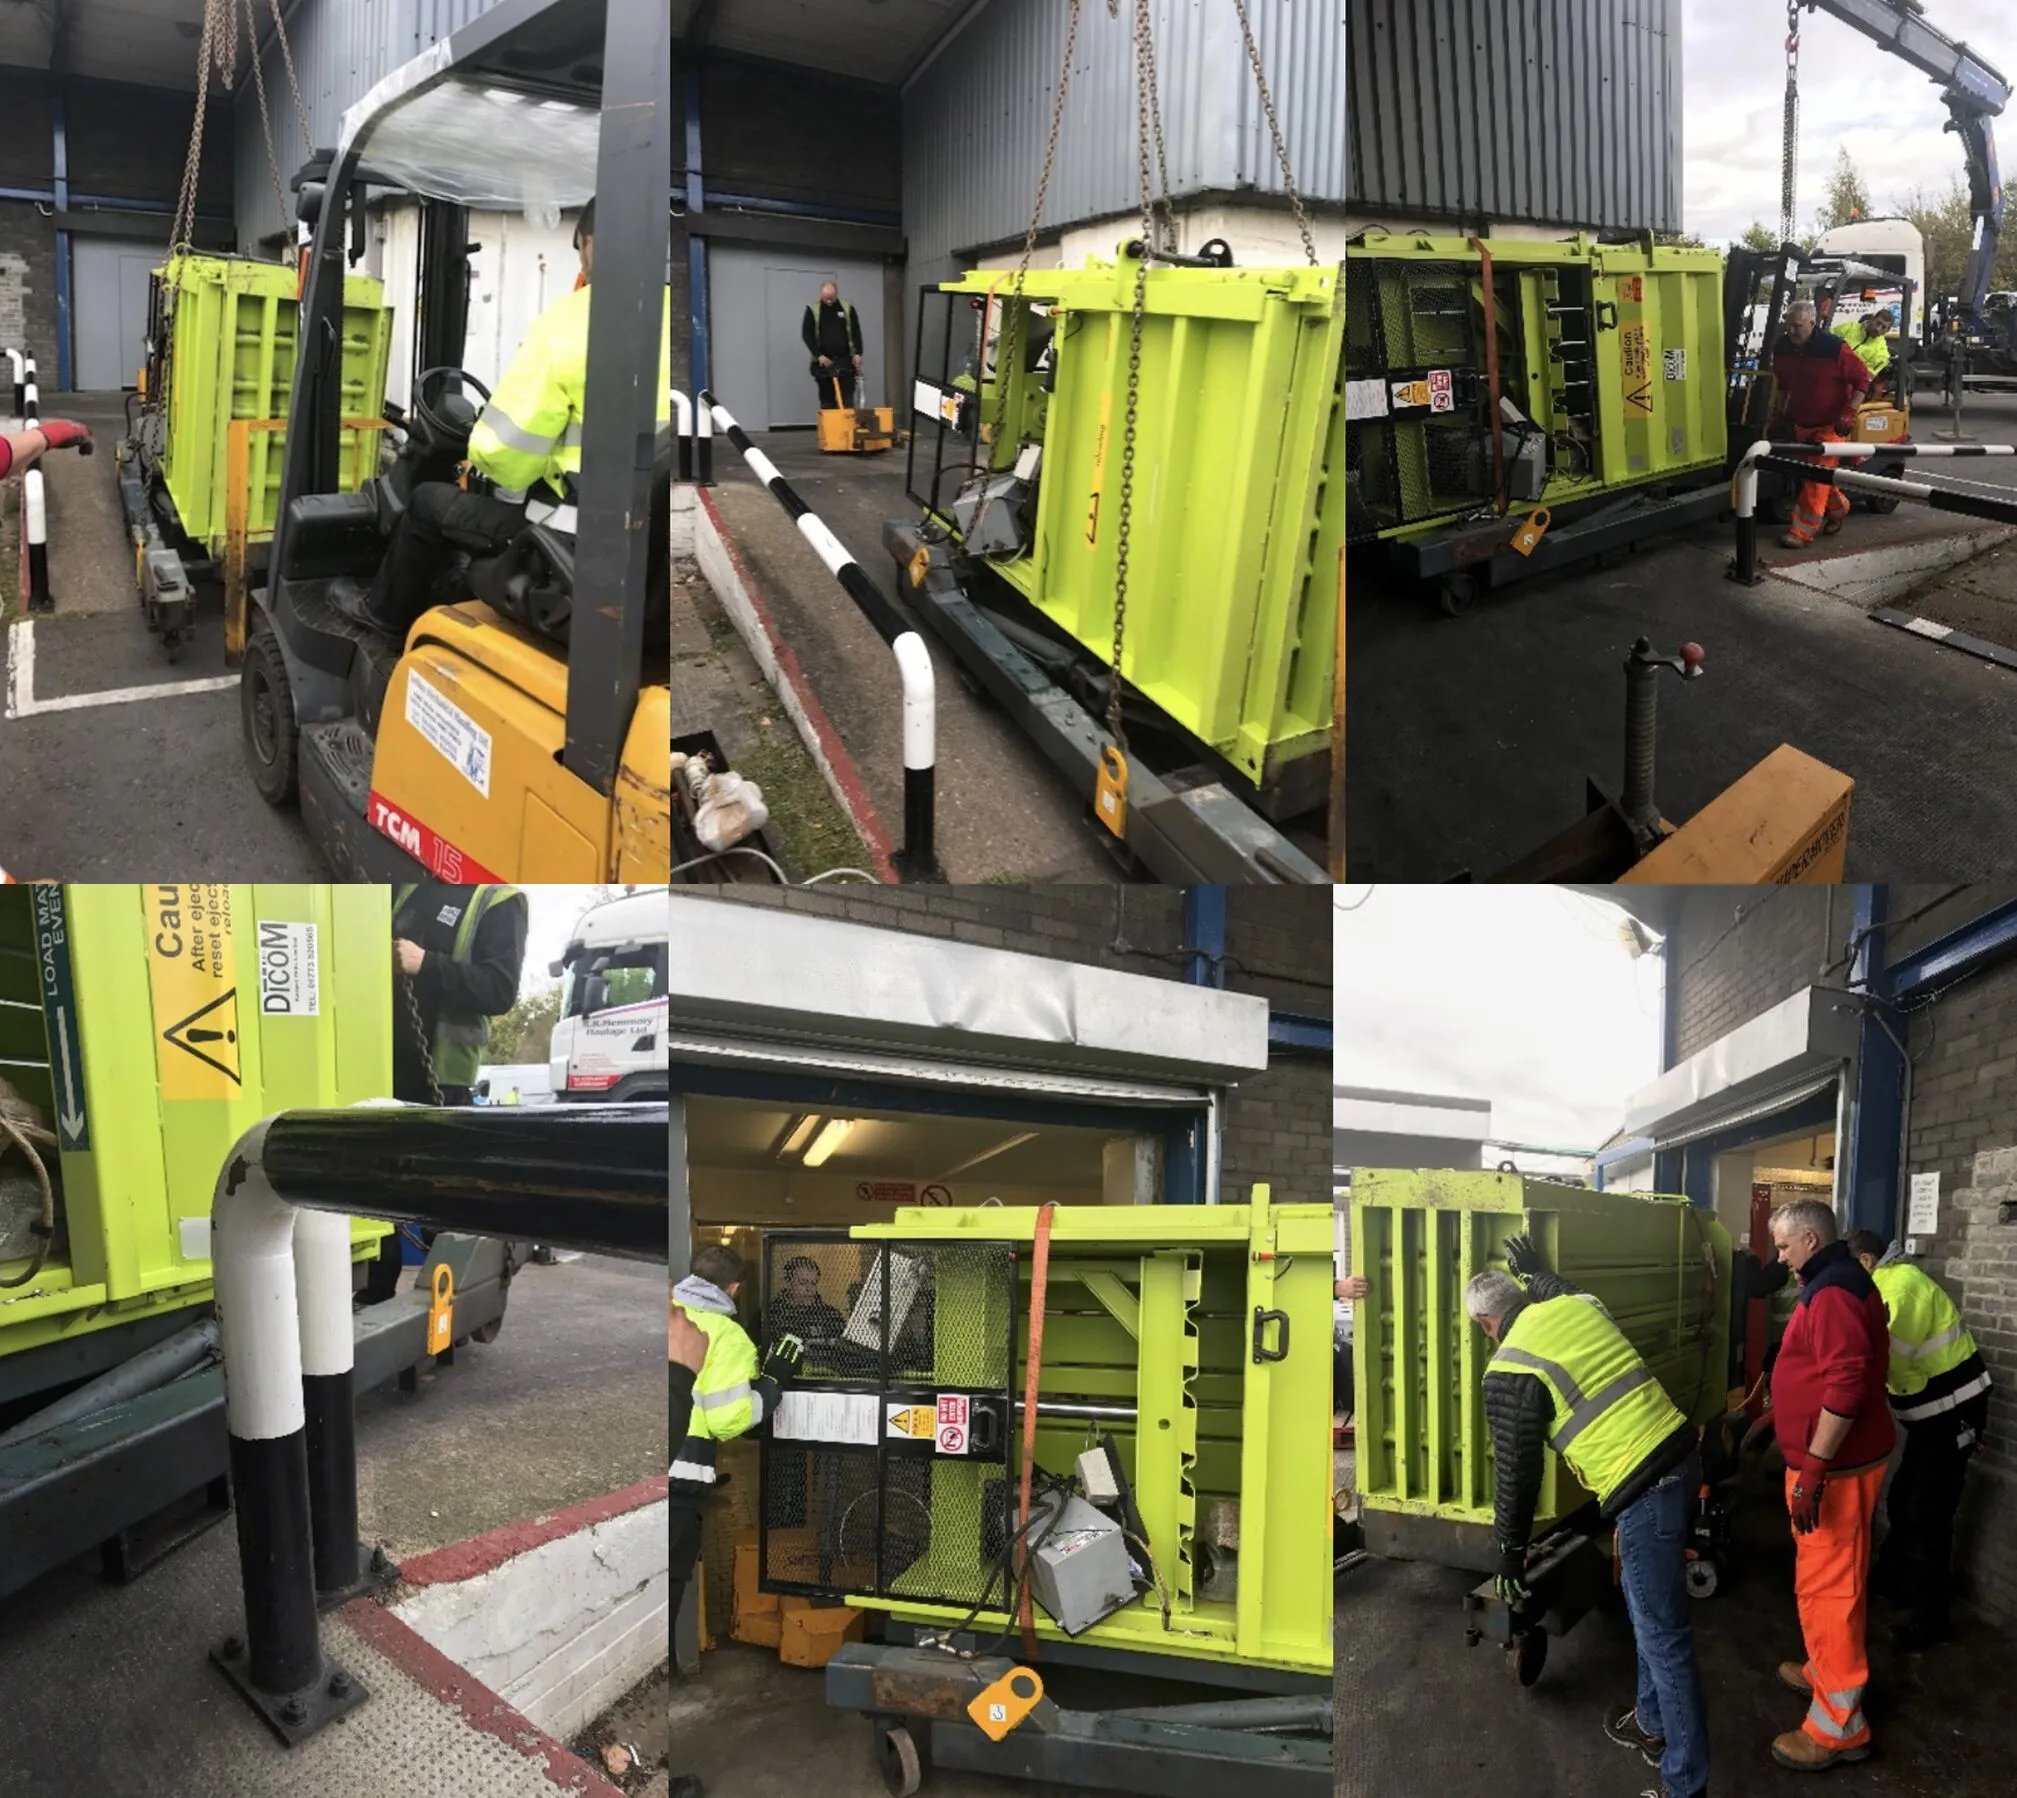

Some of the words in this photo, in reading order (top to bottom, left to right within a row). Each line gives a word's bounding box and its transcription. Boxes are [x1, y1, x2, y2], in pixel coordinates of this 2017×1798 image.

[1623, 332, 1634, 376] Caution
[375, 802, 421, 857] TCM
[432, 835, 463, 884] 15
[155, 885, 183, 958] Cau
[190, 926, 206, 972] After
[41, 932, 58, 997] LOAD
[208, 932, 223, 979] reset
